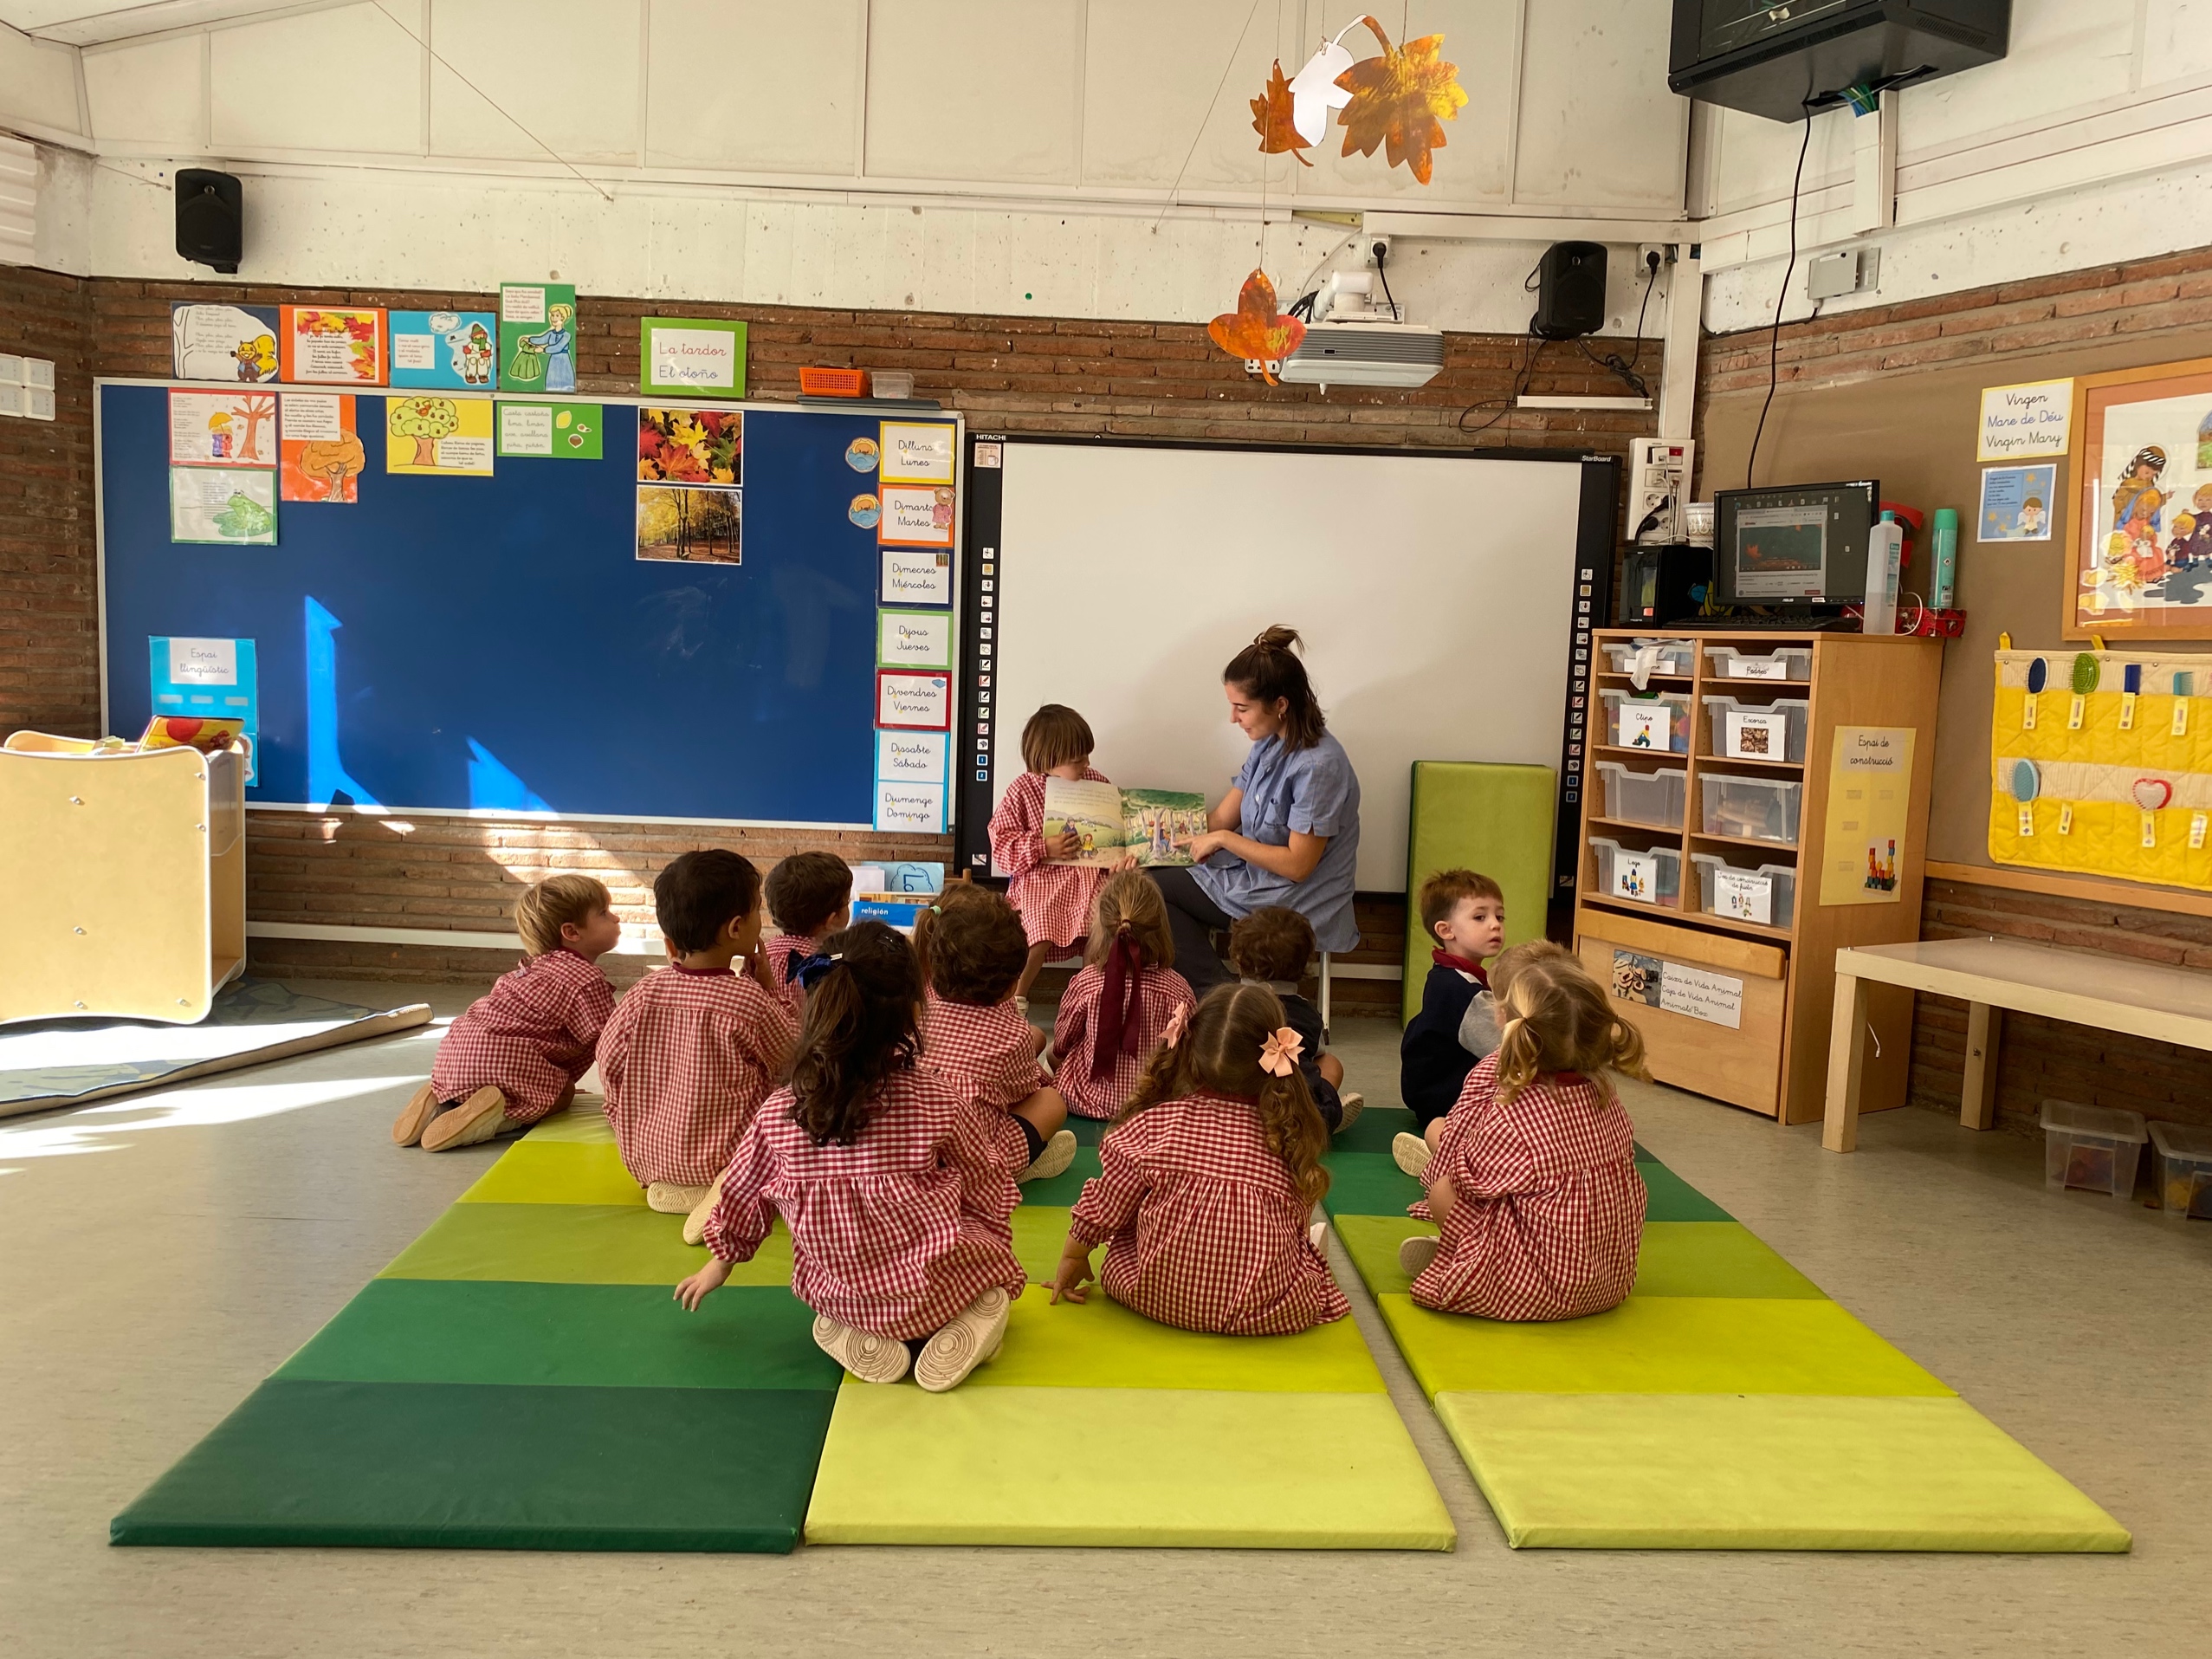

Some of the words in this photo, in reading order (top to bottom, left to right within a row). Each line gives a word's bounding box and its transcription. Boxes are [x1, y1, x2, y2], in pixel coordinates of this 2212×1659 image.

[659, 341, 677, 355] La
[681, 342, 727, 357] tardor
[659, 365, 675, 378] El
[679, 366, 718, 379] otoño
[2006, 392, 2048, 410] Virgen
[1988, 415, 2017, 428] Mare
[2021, 412, 2035, 424] de
[2040, 410, 2064, 423] Déu
[898, 439, 933, 450] Dilluns
[1986, 435, 2026, 451] Virgin
[2028, 431, 2062, 447] Mary
[901, 456, 930, 466] Lunes
[897, 515, 930, 527] Martes
[892, 562, 936, 574] Dimecres
[892, 578, 936, 589] Miércoles
[898, 625, 928, 639] Dijous
[896, 640, 930, 651] Jueves
[191, 647, 217, 662] Espai
[887, 685, 937, 697] Divendres
[893, 701, 930, 712] Viernes
[890, 742, 931, 755] Dissabte
[1858, 734, 1879, 752] Espai
[1880, 736, 1890, 748] de
[892, 758, 928, 769] Sábado
[1849, 755, 1894, 766] construcció
[884, 793, 934, 808] Diumenge
[886, 807, 930, 823] Domingo
[1627, 857, 1641, 868] Lego
[861, 906, 889, 916] religión
[1662, 971, 1683, 983] Caixa
[1684, 977, 1693, 986] de
[1693, 979, 1711, 990] Vida
[1711, 984, 1743, 998] Animal
[1661, 984, 1677, 997] Caja
[1687, 991, 1704, 1002] Vida
[1704, 996, 1736, 1011] Animal
[1693, 1006, 1709, 1018] Box
